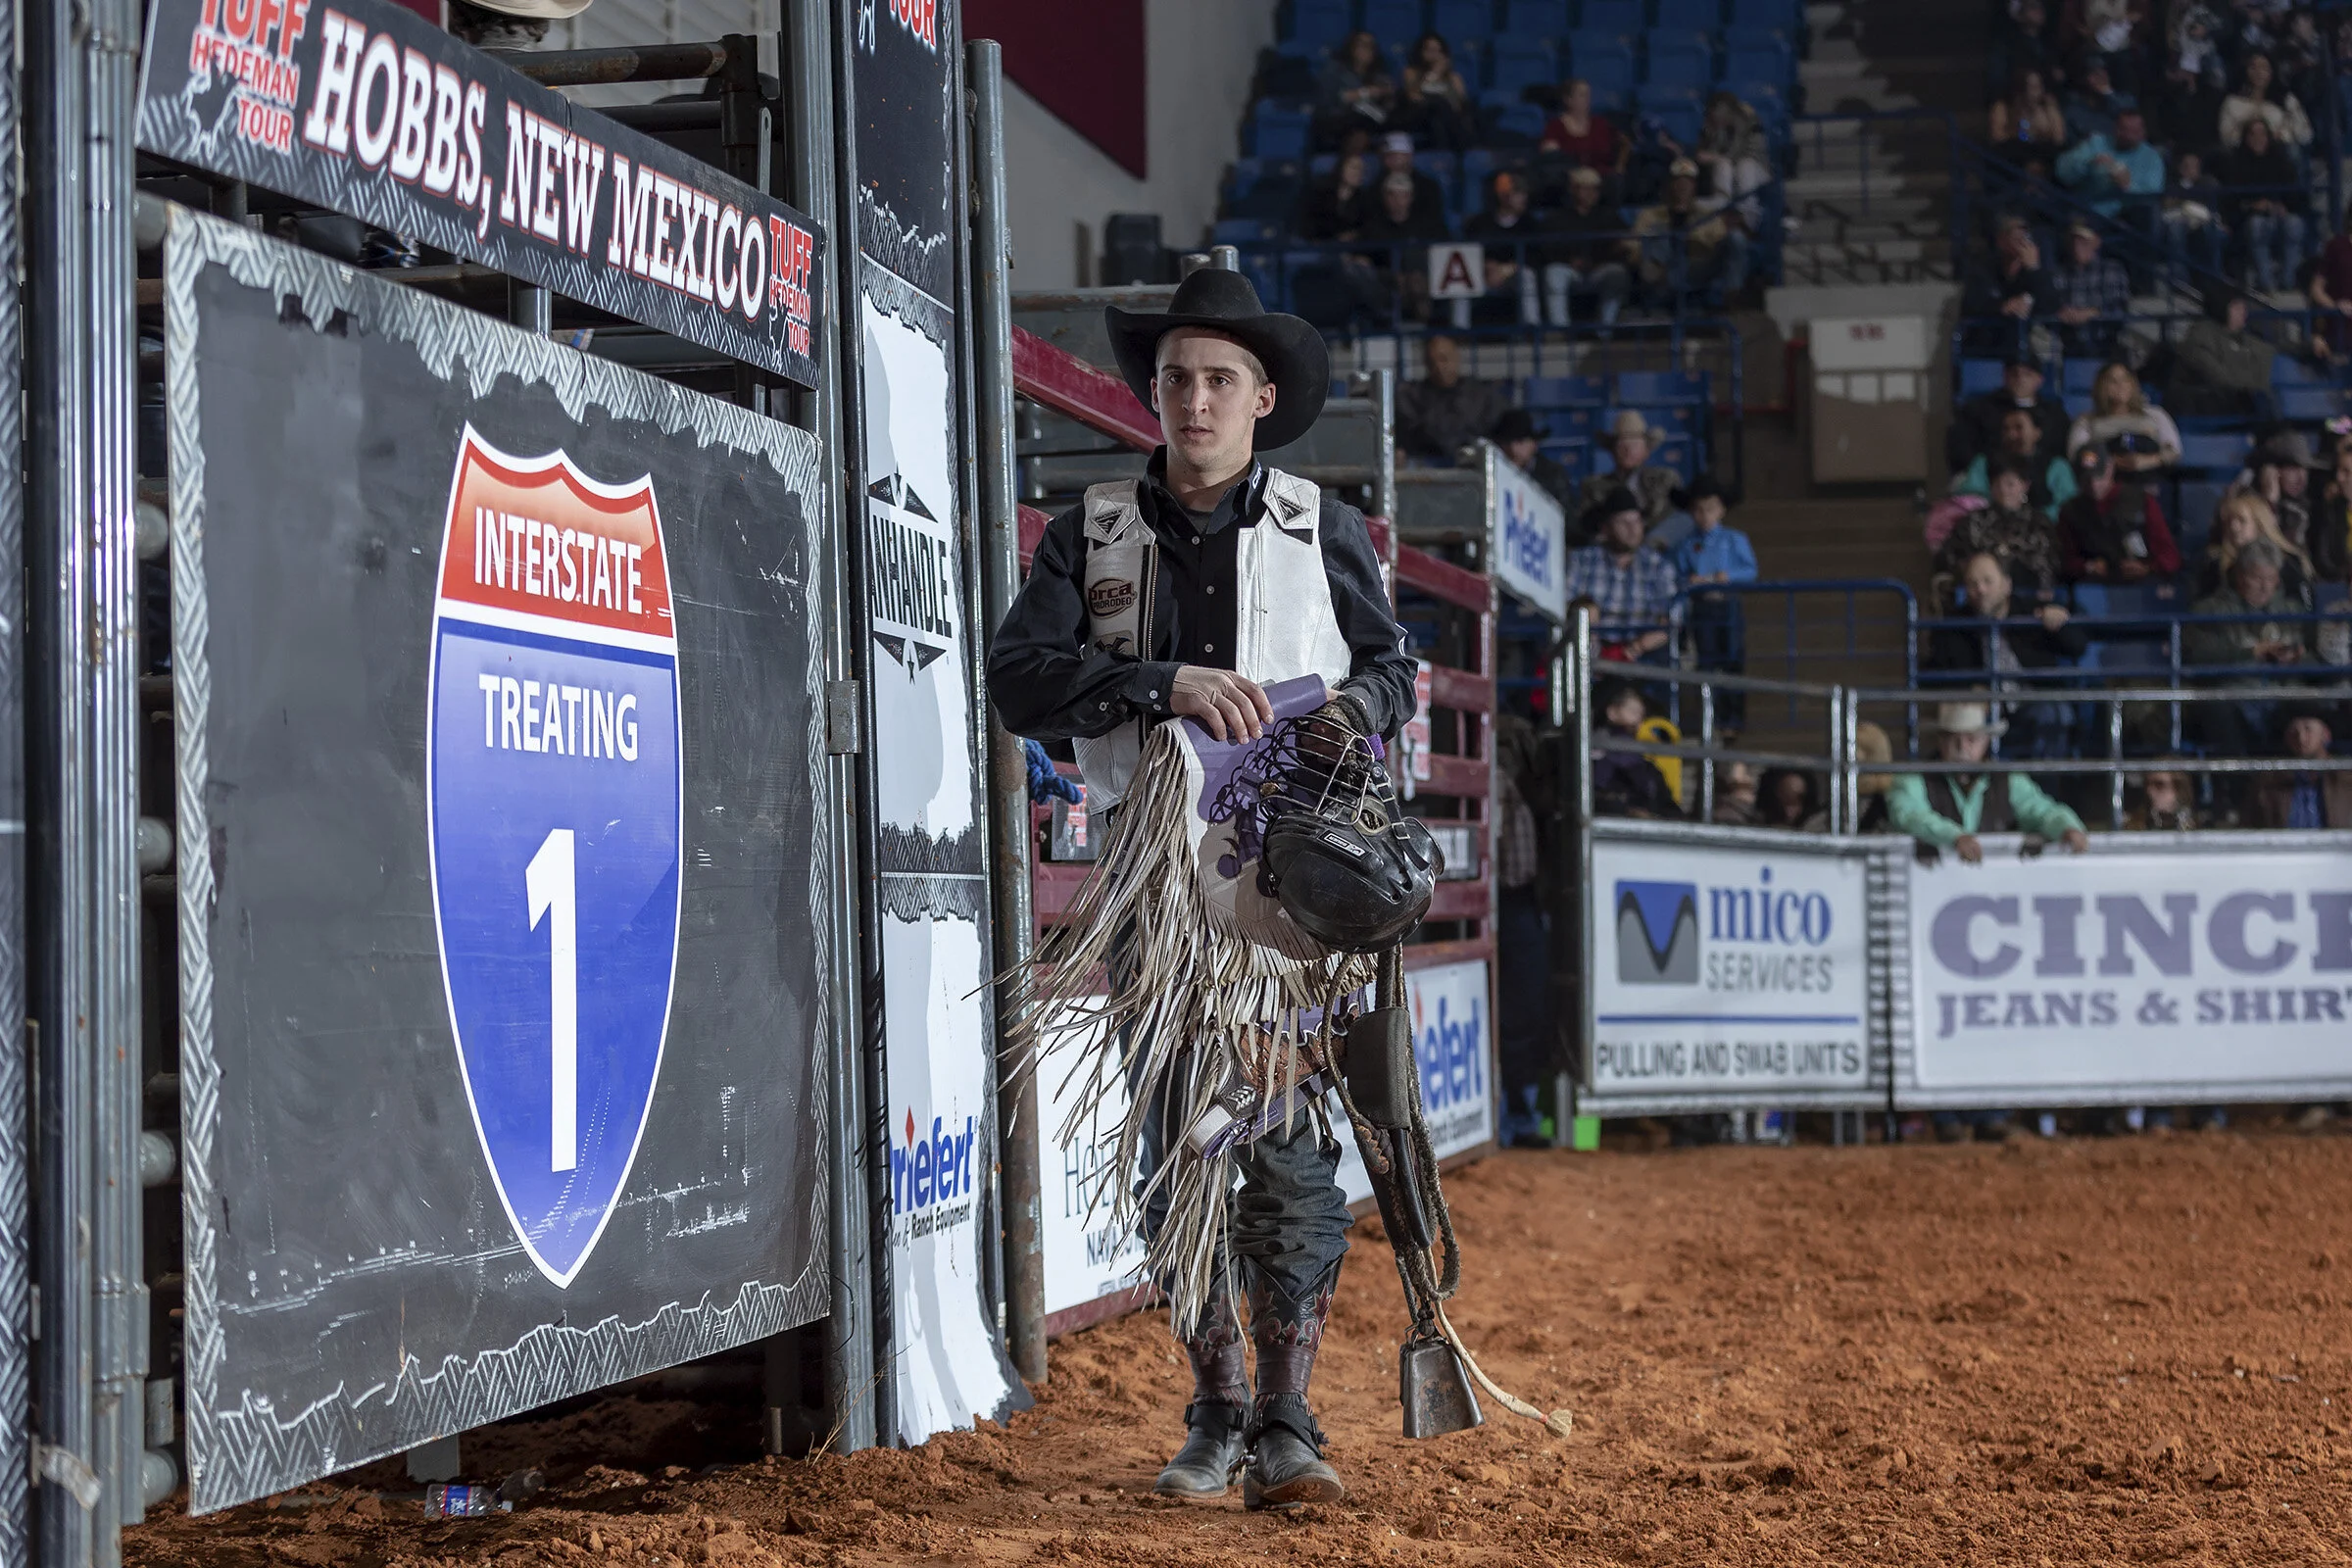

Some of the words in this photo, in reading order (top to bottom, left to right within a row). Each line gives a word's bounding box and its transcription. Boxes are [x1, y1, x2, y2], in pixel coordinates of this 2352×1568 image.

[237, 97, 294, 155] TOUR
[303, 8, 493, 244] HOBBS,
[498, 99, 606, 259] NEW
[607, 152, 766, 322] MEXICO
[769, 214, 813, 291] TUFF
[1440, 251, 1474, 291] A
[787, 319, 810, 357] TOUR
[475, 506, 644, 615] INTERSTATE
[478, 673, 639, 762] TREATING
[1708, 866, 1833, 947] mico
[526, 828, 577, 1173] 1
[1707, 952, 1835, 994] SERVICES
[1936, 990, 2120, 1040] JEANS
[2136, 989, 2180, 1025] &
[2196, 986, 2352, 1024] SHIR
[1596, 1042, 1687, 1079] PULLING
[1690, 1043, 1731, 1077] AND
[1733, 1041, 1788, 1077] SWAB
[1791, 1041, 1862, 1076] UNITS
[936, 1198, 971, 1237] Equipment
